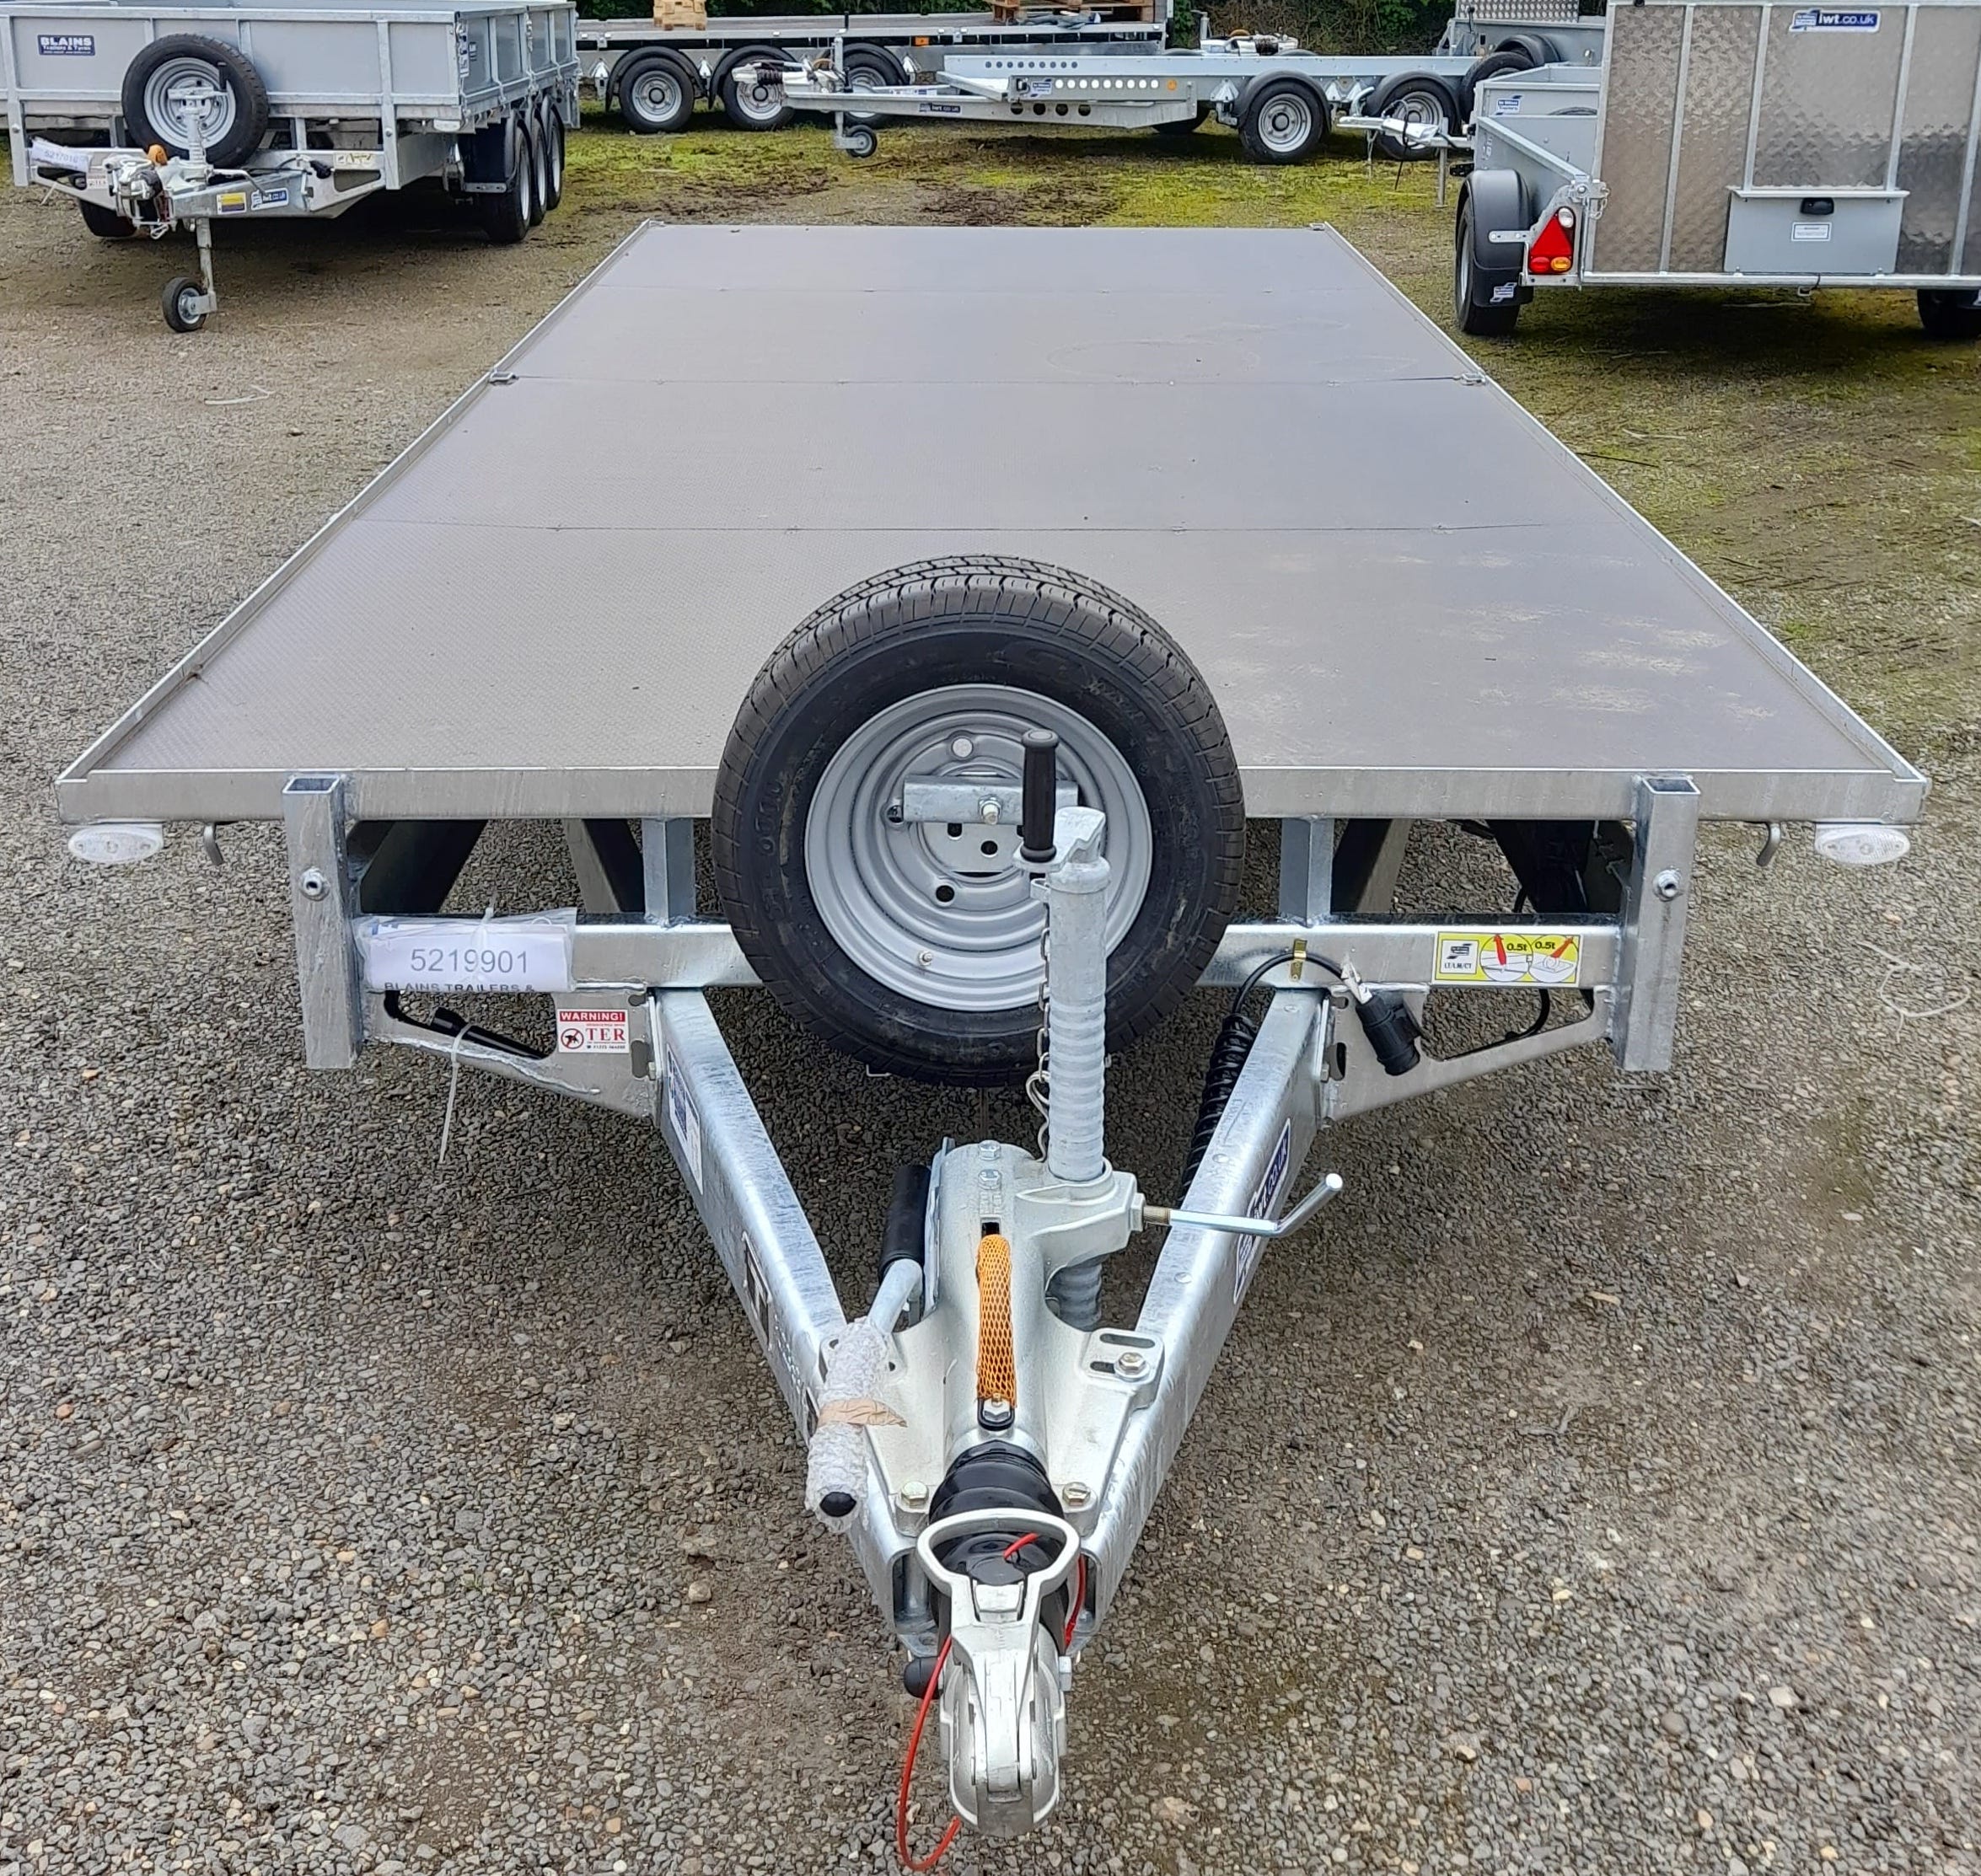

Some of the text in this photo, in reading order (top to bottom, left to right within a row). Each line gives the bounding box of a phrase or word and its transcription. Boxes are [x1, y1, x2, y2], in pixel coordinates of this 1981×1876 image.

[1818, 13, 1875, 24] iwt.co.uk
[40, 36, 92, 46] BLAINS
[411, 948, 526, 973] 5219901
[384, 982, 440, 991] BLAINS
[445, 984, 521, 992] TRAILERS
[561, 1012, 623, 1021] WARNING!
[586, 1027, 625, 1041] TER
